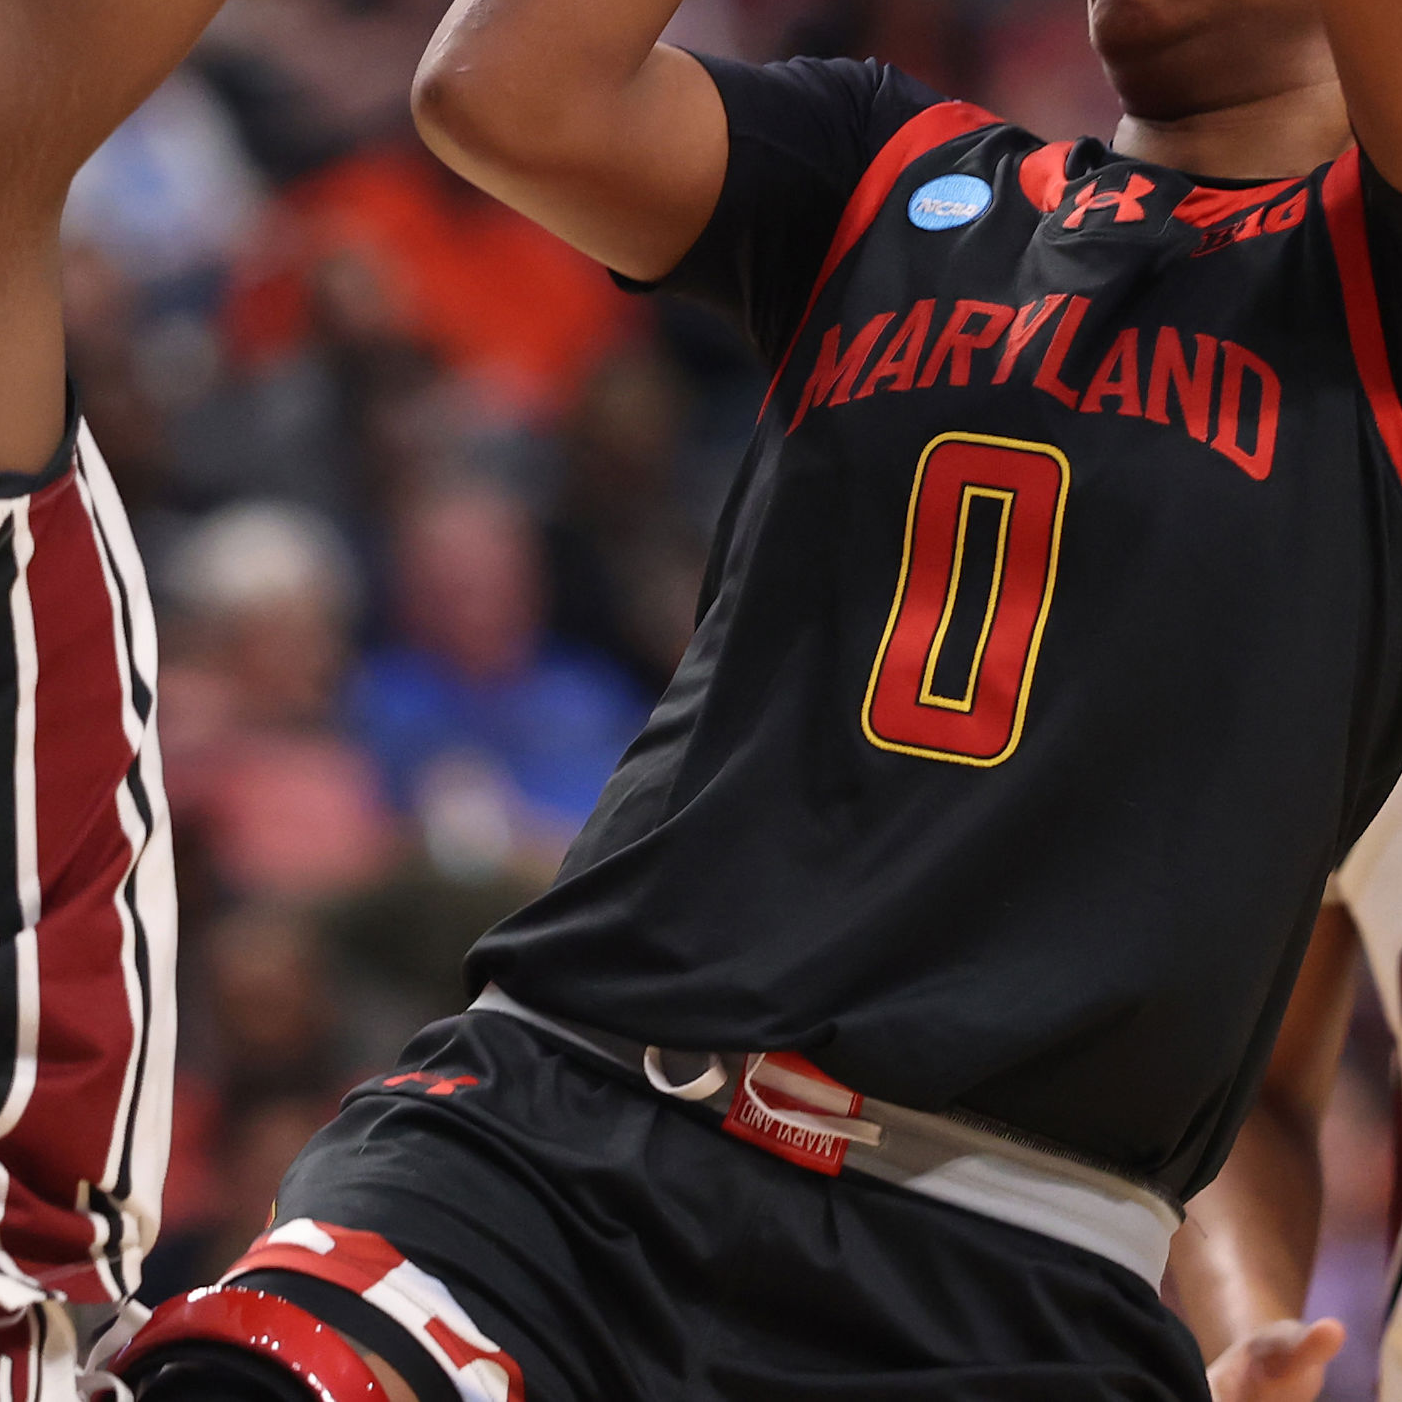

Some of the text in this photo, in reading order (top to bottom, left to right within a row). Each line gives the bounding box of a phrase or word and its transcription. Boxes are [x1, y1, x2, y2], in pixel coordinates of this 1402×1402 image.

[915, 197, 980, 219] NCAA
[785, 293, 1281, 481] MARYLAND
[861, 430, 1071, 768] 0
